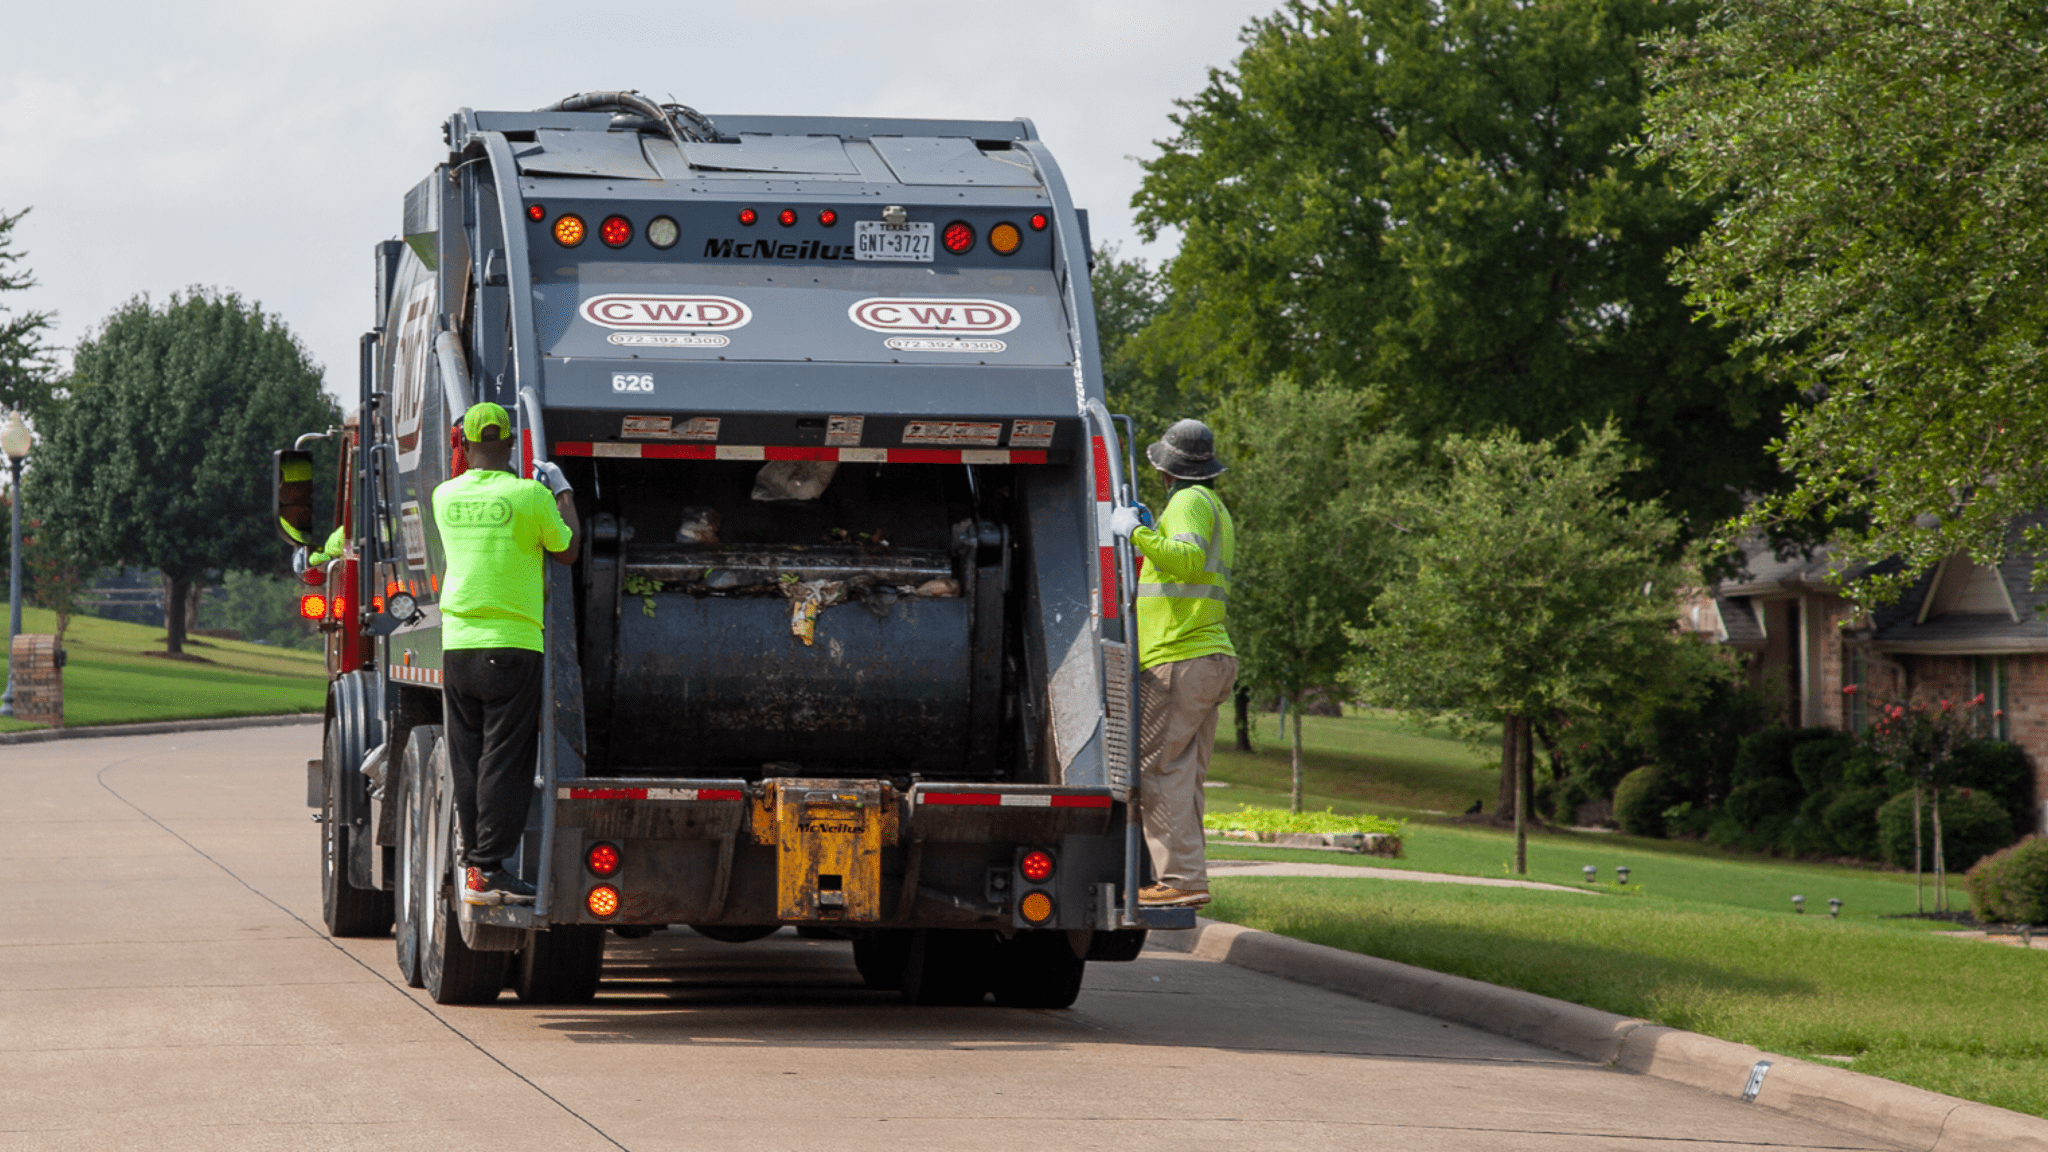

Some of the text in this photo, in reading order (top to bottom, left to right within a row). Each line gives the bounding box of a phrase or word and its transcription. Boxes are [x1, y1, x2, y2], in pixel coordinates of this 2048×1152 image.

[880, 223, 911, 232] TEXAS
[703, 238, 855, 260] McNeilus
[602, 303, 729, 321] CWD
[870, 307, 998, 325] CWD
[612, 375, 655, 392] 626
[795, 823, 866, 834] McNeilus
